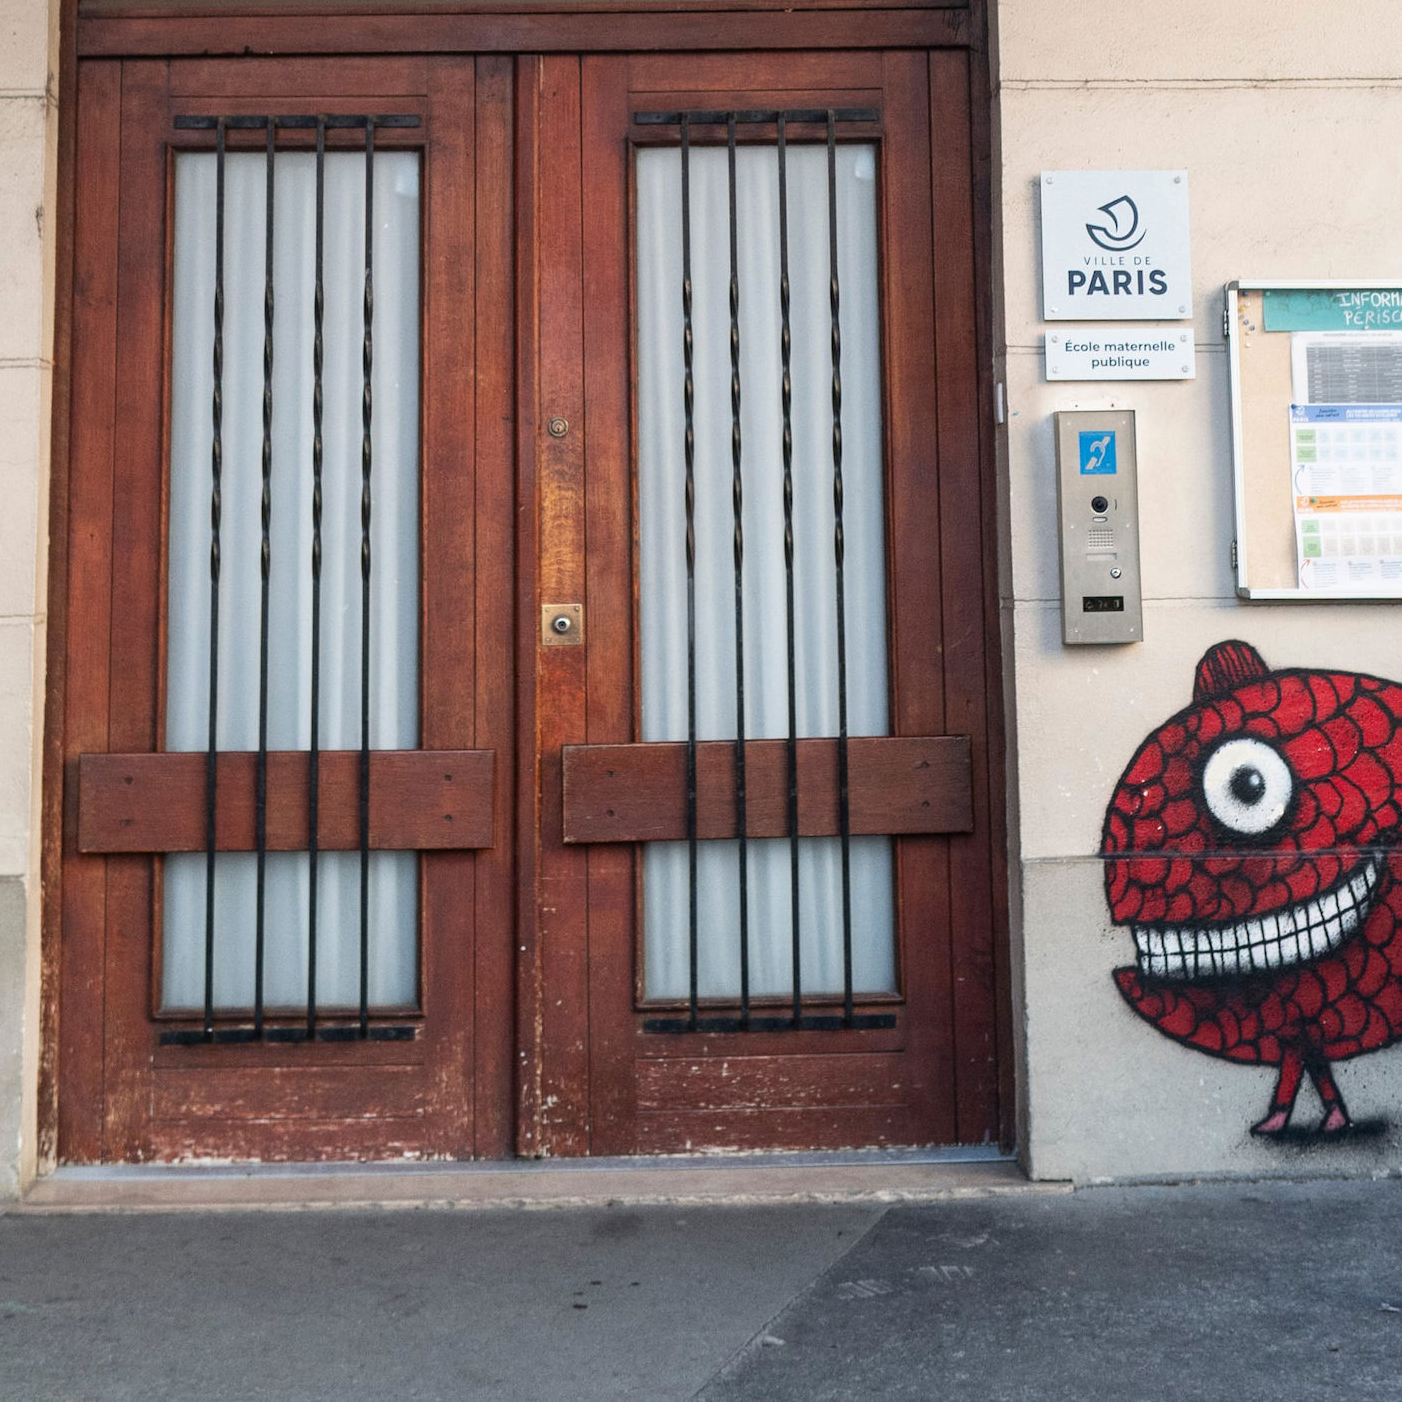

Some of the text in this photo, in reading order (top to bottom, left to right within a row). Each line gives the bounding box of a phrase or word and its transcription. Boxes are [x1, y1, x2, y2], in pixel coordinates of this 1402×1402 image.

[1083, 256, 1151, 266] VILLE DE
[1067, 269, 1169, 296] PARIS
[1065, 339, 1176, 352] École maternelle
[1091, 356, 1151, 370] publique
